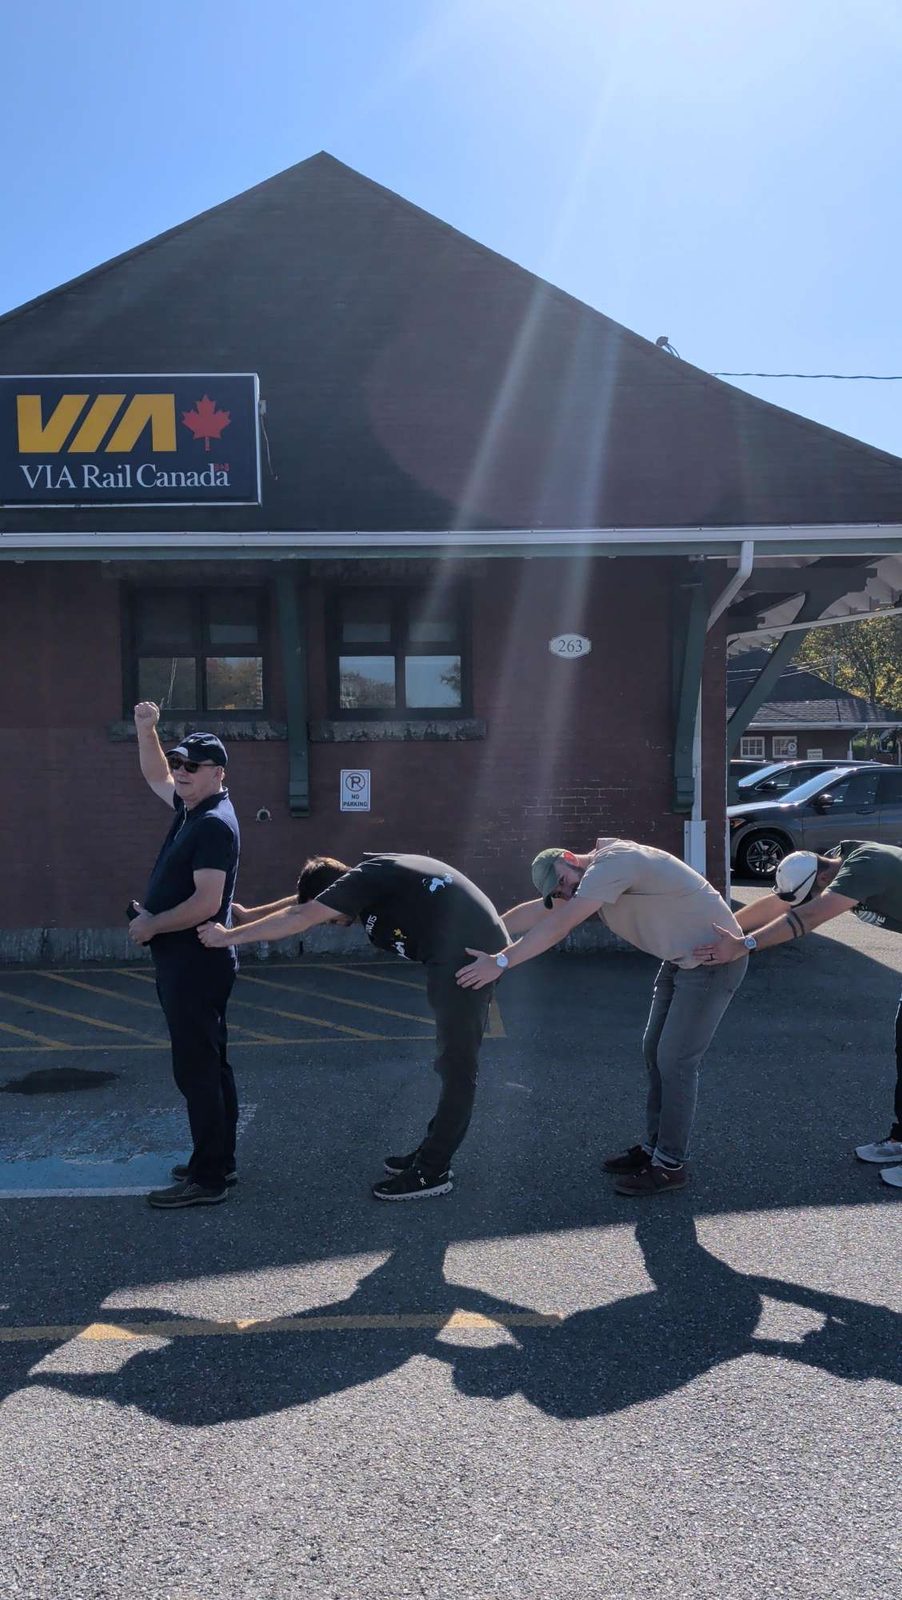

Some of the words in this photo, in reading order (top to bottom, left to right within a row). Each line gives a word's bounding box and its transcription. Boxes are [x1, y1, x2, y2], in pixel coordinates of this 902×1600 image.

[17, 394, 177, 453] VIA
[20, 465, 77, 488] VIA
[82, 464, 132, 488] Rail
[136, 463, 231, 488] Canada
[558, 639, 583, 653] 263
